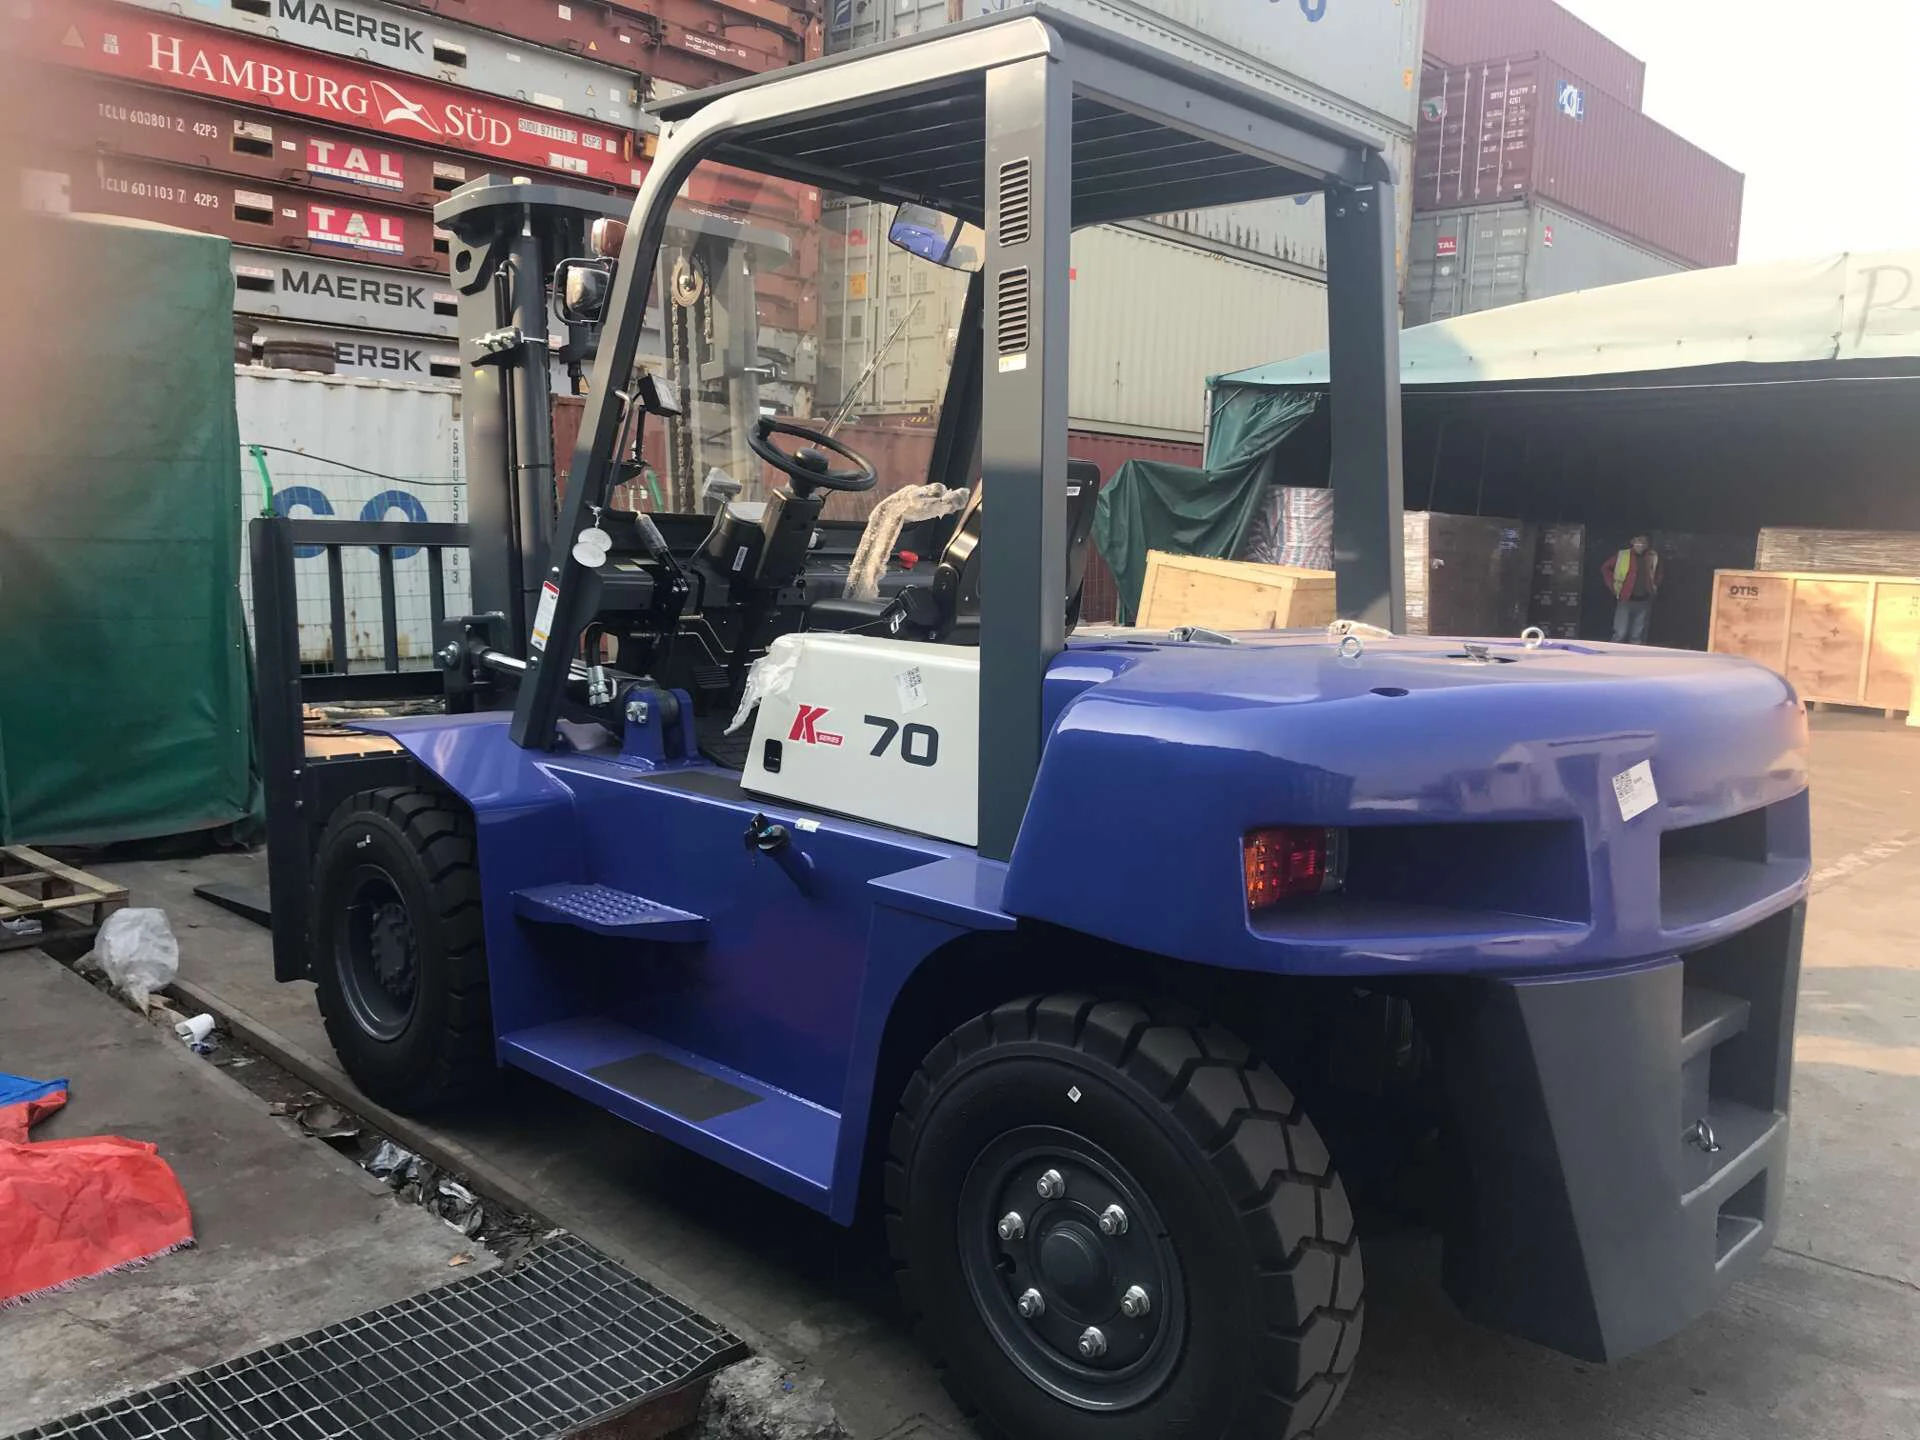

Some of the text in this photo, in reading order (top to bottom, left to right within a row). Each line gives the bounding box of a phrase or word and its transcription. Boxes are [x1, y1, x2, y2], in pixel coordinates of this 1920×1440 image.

[278, 0, 424, 54] MAERSK
[147, 32, 512, 147] HAMBURG SÜD
[176, 118, 185, 132] 2
[192, 122, 218, 138] 42P3
[309, 138, 400, 178] TAL
[131, 182, 173, 201] 601103
[179, 189, 186, 203] 7
[193, 192, 219, 209] 42P3
[310, 206, 401, 241] TAL
[282, 268, 426, 309] MAERSK
[335, 342, 423, 372] ERSK
[1730, 585, 1759, 596] OTIS
[788, 704, 830, 744] K
[818, 734, 841, 744] SERIES
[864, 714, 939, 767] 70
